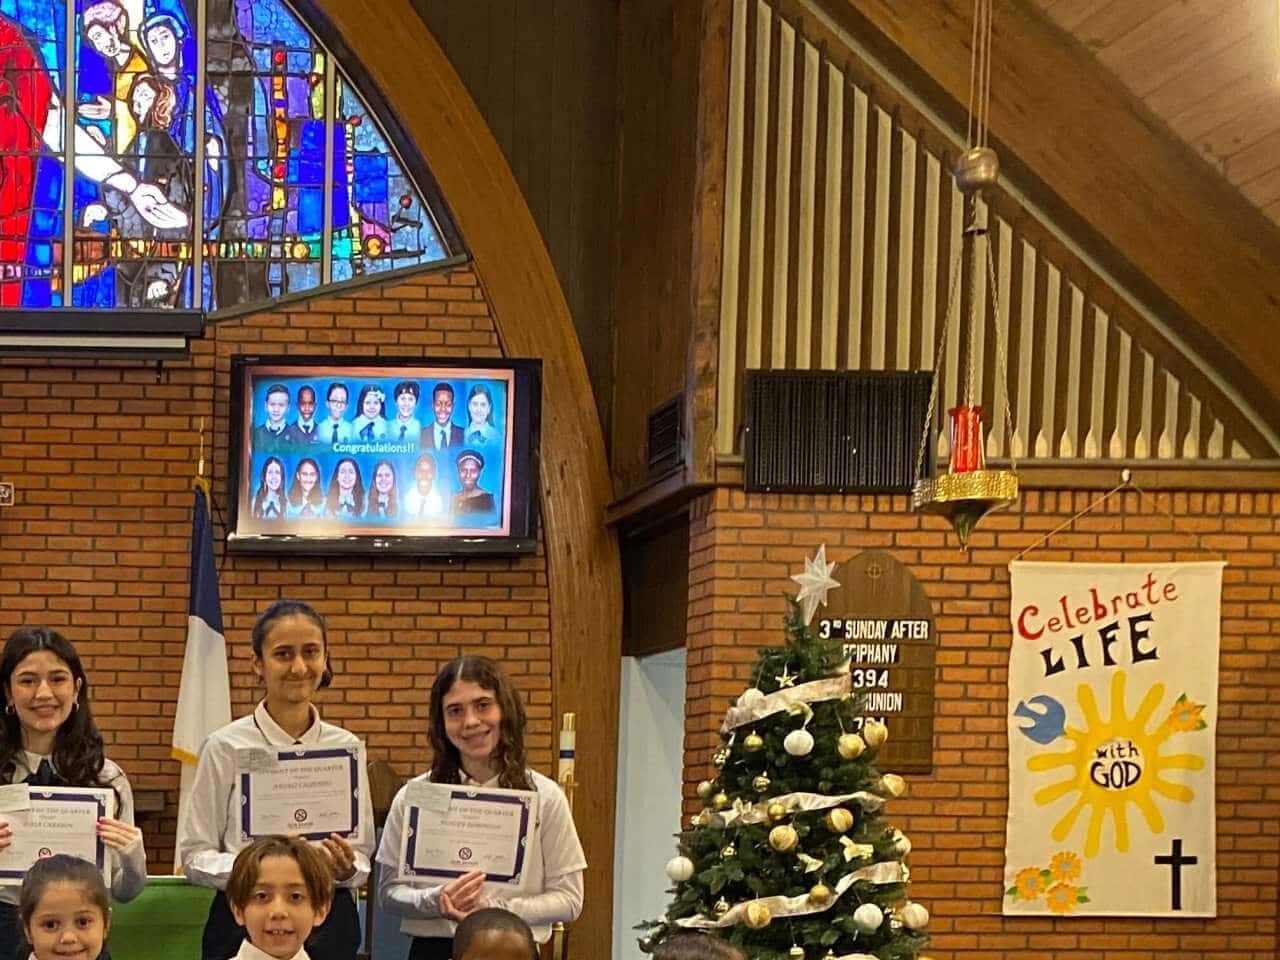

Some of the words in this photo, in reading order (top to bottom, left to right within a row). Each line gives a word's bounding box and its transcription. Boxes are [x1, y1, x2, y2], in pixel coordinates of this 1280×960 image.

[332, 442, 415, 455] Congratulations!!
[1017, 572, 1179, 641] Celebrate
[845, 620, 887, 639] SUNDAY
[891, 620, 929, 639] AFTER
[1040, 612, 1160, 677] LIFE
[853, 669, 889, 688] 394
[1095, 741, 1139, 758] with
[1090, 761, 1141, 789] GOD
